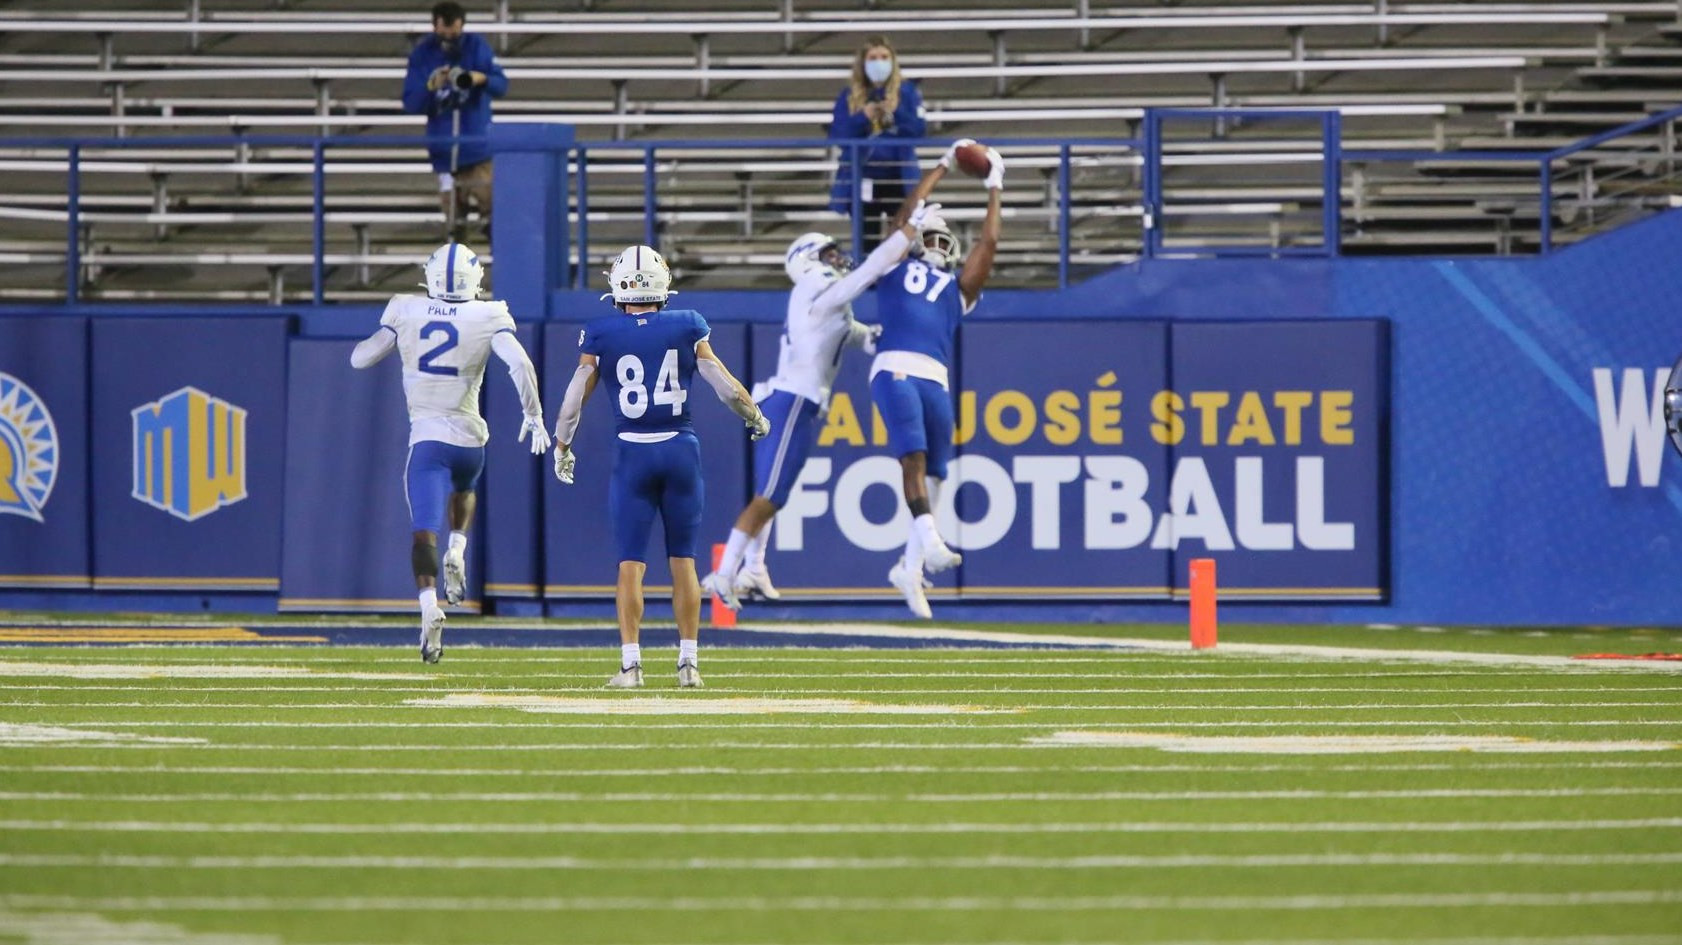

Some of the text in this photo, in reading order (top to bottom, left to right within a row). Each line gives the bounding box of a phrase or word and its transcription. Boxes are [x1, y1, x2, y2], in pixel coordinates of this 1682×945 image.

[427, 305, 457, 317] PALM
[903, 261, 955, 302] 87
[418, 320, 459, 376] 2
[616, 349, 688, 419] 84
[952, 371, 1124, 446] JOSÉ
[1151, 391, 1355, 446] STATE
[131, 386, 248, 522] MW
[775, 455, 1356, 552] FOOTBALL
